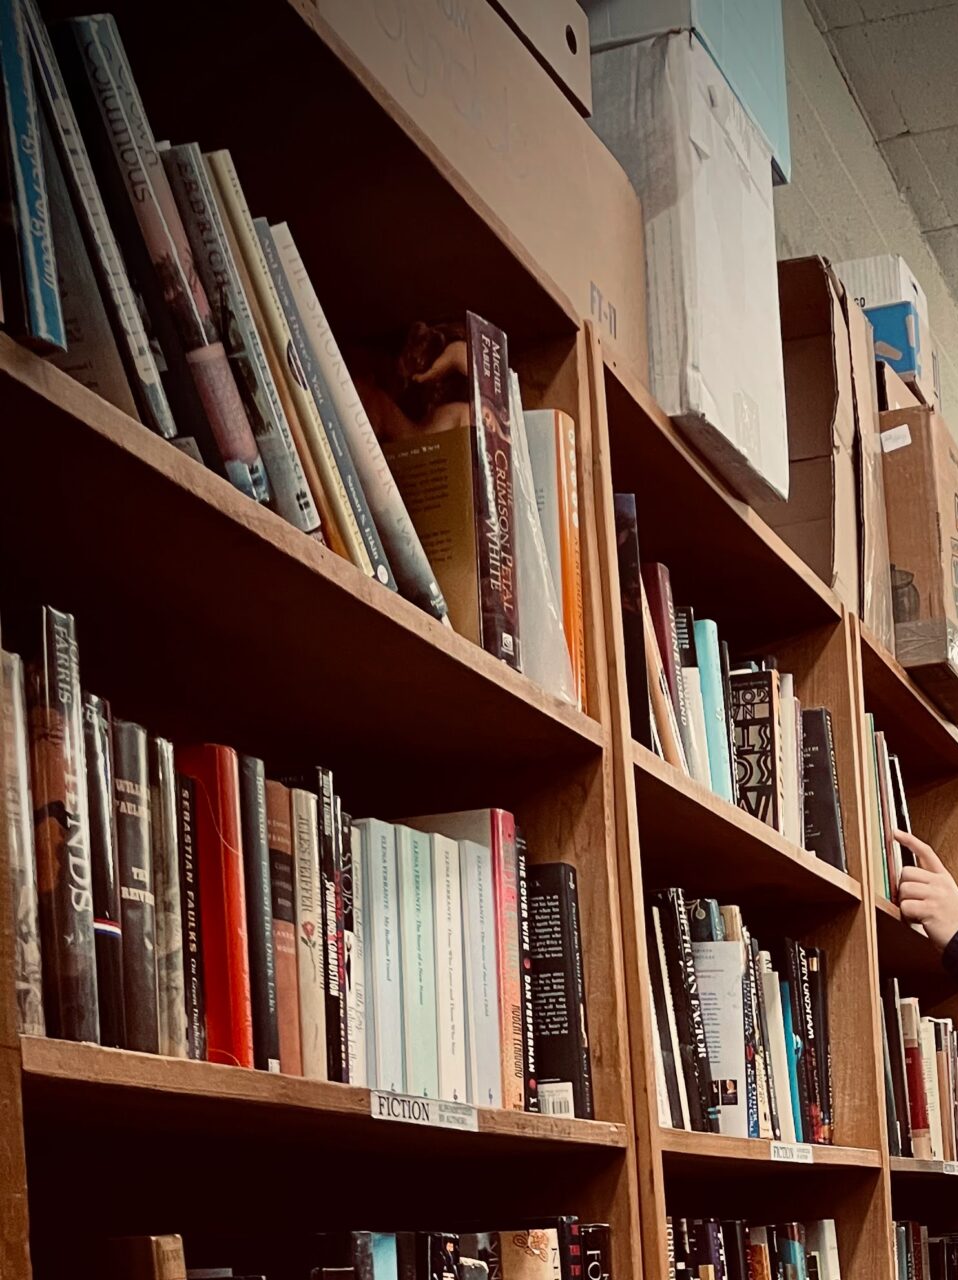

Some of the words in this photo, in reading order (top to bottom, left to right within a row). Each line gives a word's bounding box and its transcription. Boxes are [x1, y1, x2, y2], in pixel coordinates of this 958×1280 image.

[85, 39, 153, 205] Columbus
[175, 158, 231, 292] ERDRICH
[480, 333, 492, 378] FABER
[491, 338, 502, 396] MICHEL
[305, 297, 350, 393] SMOKE
[349, 393, 396, 499] JUMPER
[494, 448, 511, 545] CRIMSON
[487, 516, 503, 593] WHITE
[499, 545, 515, 614] PETAL
[53, 622, 74, 705] FARRIS
[666, 598, 680, 661] DIVINE
[673, 662, 687, 726] HUSBAND
[182, 788, 196, 882] SEBASTIAN
[299, 815, 312, 855] JULES
[380, 834, 388, 864] ELENA
[412, 839, 420, 868] ELENA
[301, 857, 314, 912] FEIFFER
[382, 865, 390, 910] FERRANTE
[414, 869, 422, 914] FERRANTE
[518, 855, 527, 877] THE
[186, 889, 198, 954] FAULKS
[325, 879, 337, 935] SPONTANEOUS
[445, 880, 453, 922] FERRANTE
[477, 882, 485, 924] FERRANTE
[519, 879, 529, 919] COVER
[521, 922, 531, 952] WIFE
[328, 940, 340, 997] COMBUSTION
[523, 974, 533, 1000] DAN
[682, 929, 698, 995] HUMAN
[692, 998, 707, 1058] FACTOR
[525, 1002, 536, 1073] FESPERMAN
[377, 1095, 430, 1121] FICTION
[772, 1145, 794, 1161] FICTION
[666, 1226, 677, 1266] JOHN
